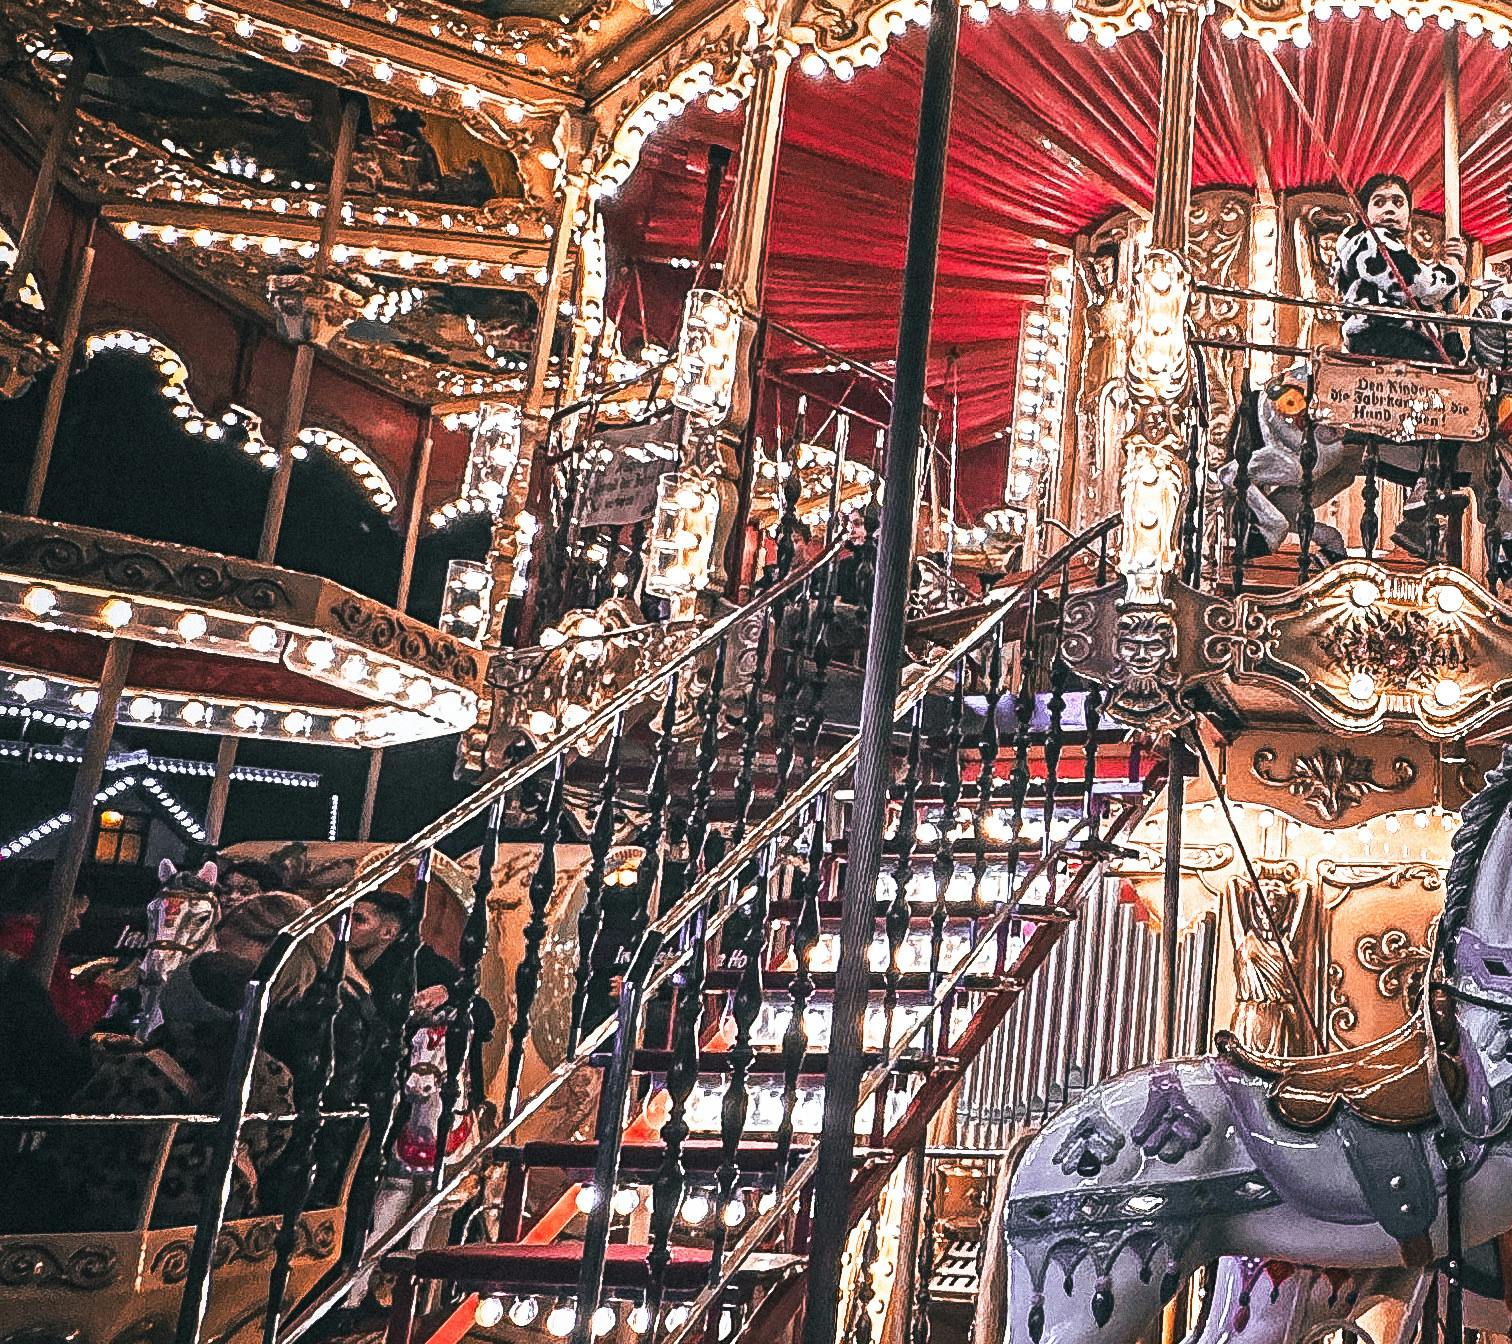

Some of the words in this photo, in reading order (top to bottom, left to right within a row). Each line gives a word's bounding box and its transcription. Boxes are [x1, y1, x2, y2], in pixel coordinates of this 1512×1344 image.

[1331, 388, 1350, 403] die
[1451, 401, 1470, 416] die
[1354, 405, 1392, 420] Hand
